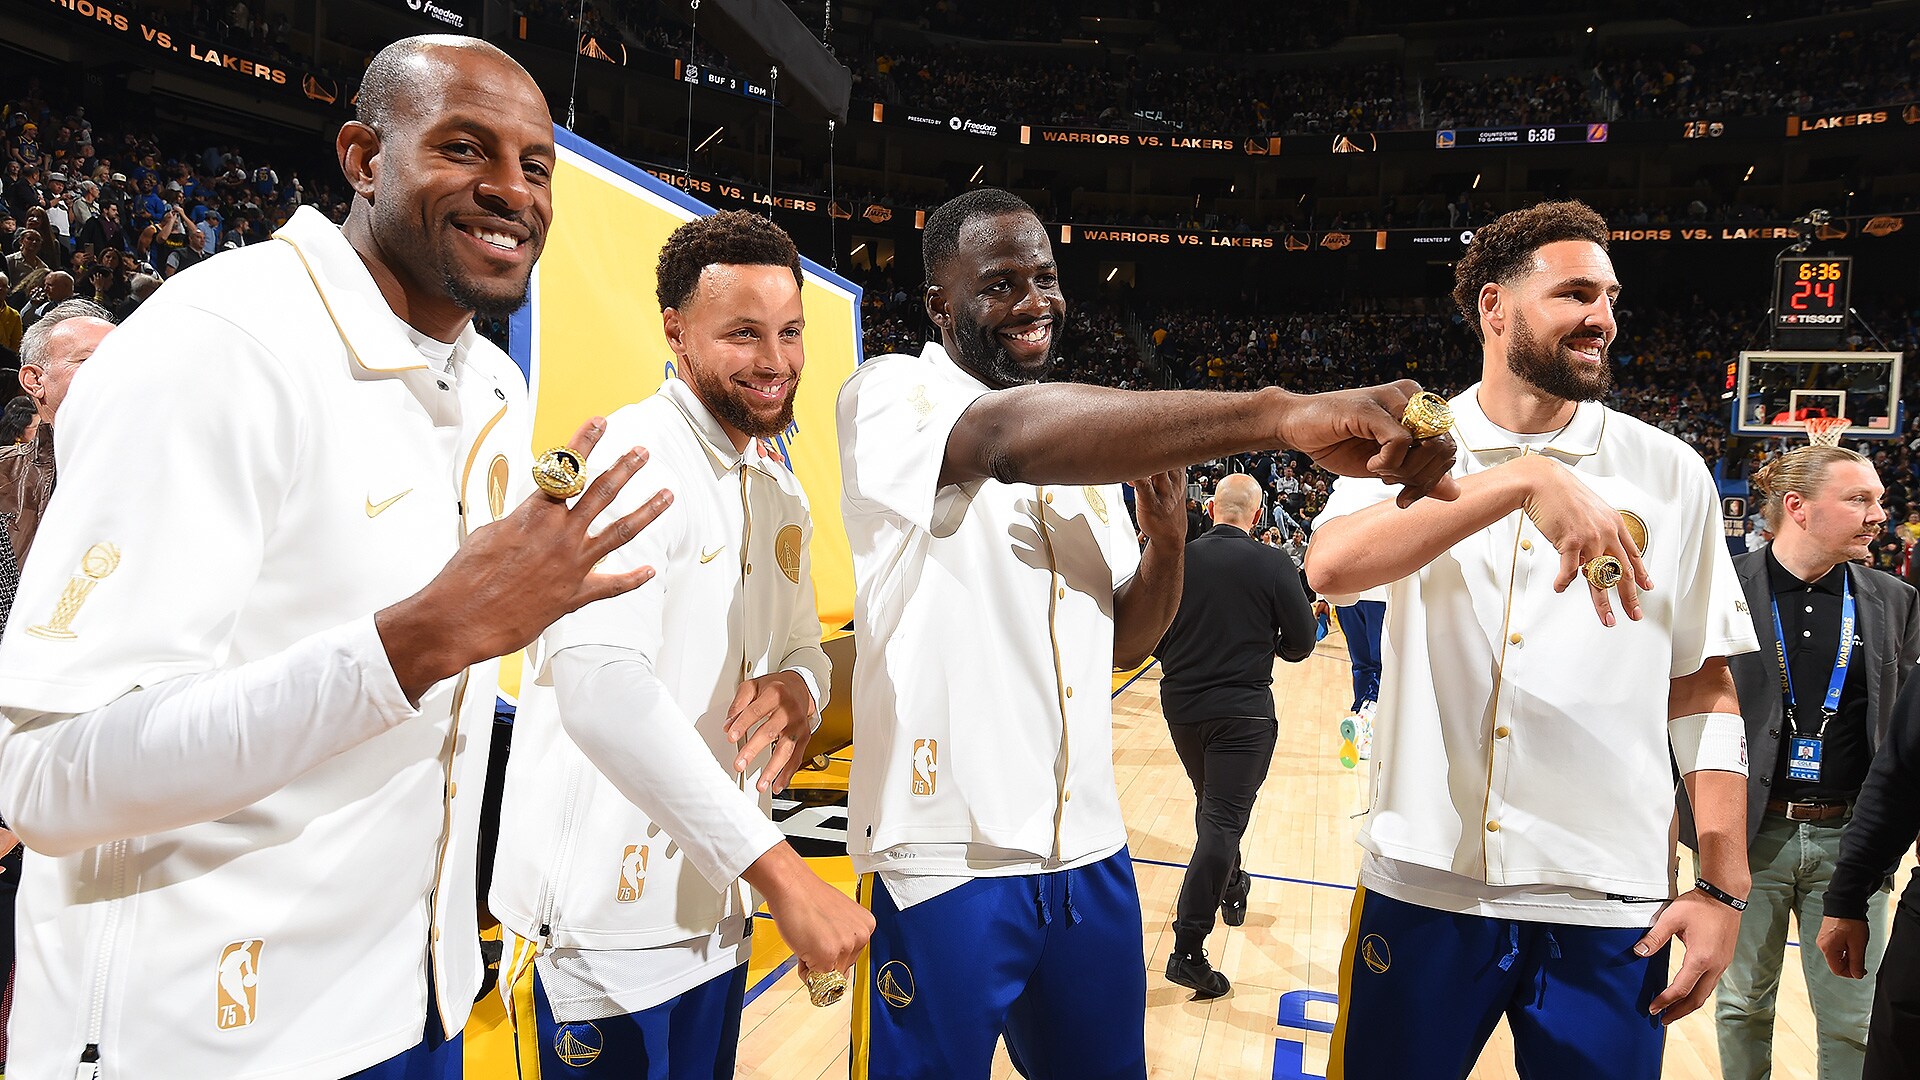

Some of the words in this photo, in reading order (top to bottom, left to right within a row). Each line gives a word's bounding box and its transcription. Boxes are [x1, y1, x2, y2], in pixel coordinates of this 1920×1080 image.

[423, 0, 463, 22] freedom
[140, 23, 178, 52] VS.
[190, 43, 287, 85] LAKERS
[708, 74, 725, 85] BUF
[730, 79, 736, 89] 3
[748, 85, 767, 96] EDM
[908, 115, 934, 124] PRESENTED
[963, 118, 997, 131] freedom
[1801, 111, 1888, 132] LAKERS
[1042, 131, 1130, 145] WARRIORS
[1138, 136, 1164, 146] VS.
[1171, 138, 1234, 150] LAKERS
[1528, 128, 1556, 143] 6:36
[718, 184, 746, 200] VS.
[752, 192, 817, 212] LAKERS
[1083, 230, 1170, 244] WARRIORS
[1177, 234, 1204, 245] VS.
[1211, 236, 1274, 248] LAKERS
[1681, 229, 1713, 240] VS.
[1722, 227, 1800, 240] LAKERS
[1798, 262, 1841, 280] 6:36
[1790, 280, 1836, 311] 24
[1797, 314, 1844, 324] TISSOT
[1836, 616, 1853, 669] WARRIORS
[914, 780, 924, 794] 75
[619, 887, 632, 900] 75
[219, 1003, 238, 1027] 75
